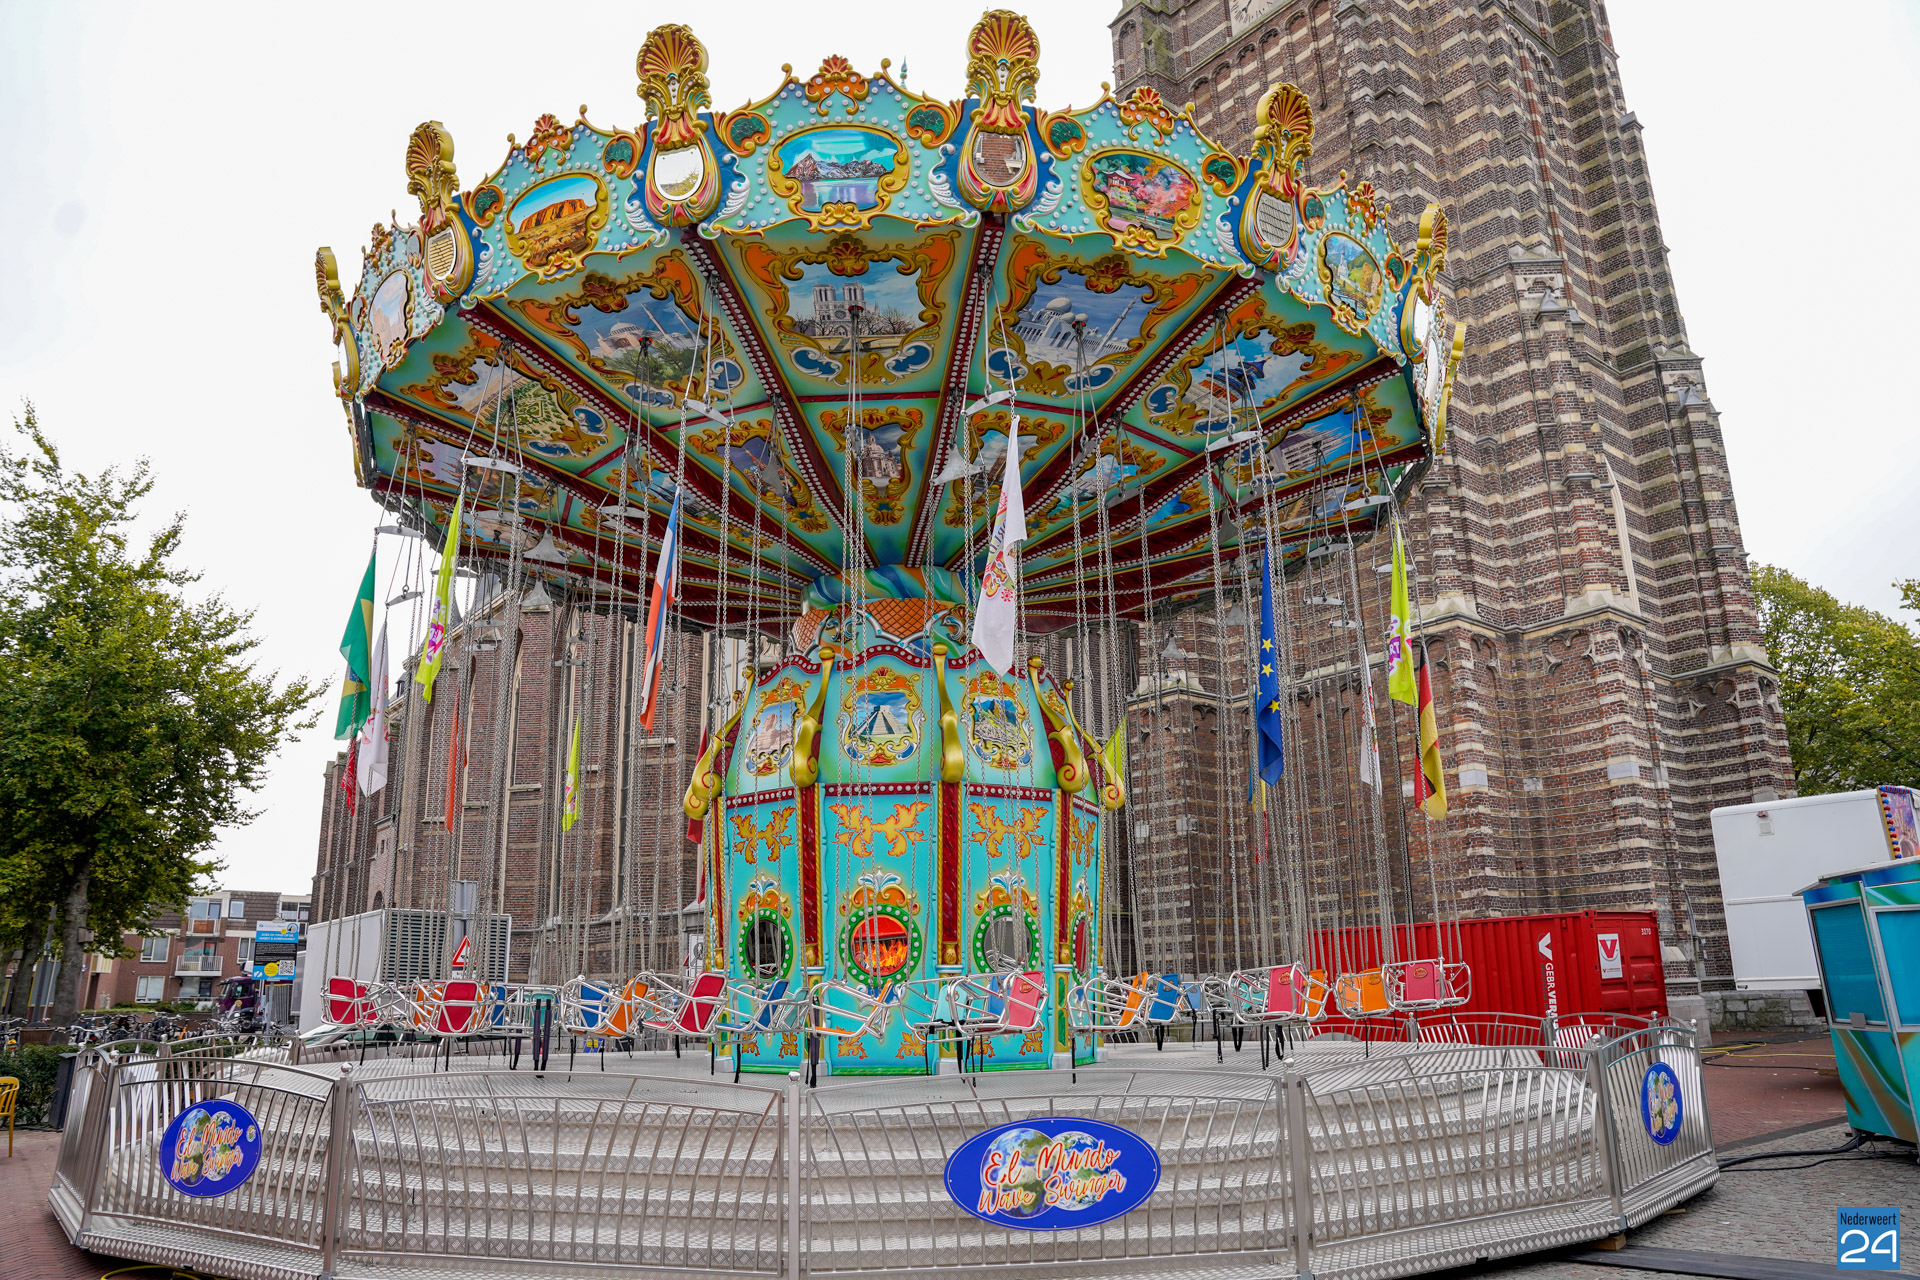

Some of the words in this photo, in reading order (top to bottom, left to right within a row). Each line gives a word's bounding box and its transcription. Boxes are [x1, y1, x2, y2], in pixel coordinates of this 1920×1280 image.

[177, 1128, 196, 1157] El
[201, 1120, 243, 1152] Mundo
[984, 1150, 1022, 1186] El
[1037, 1141, 1120, 1178] Mundo
[978, 1184, 1035, 1213] Wave
[1045, 1171, 1125, 1205] Swinger
